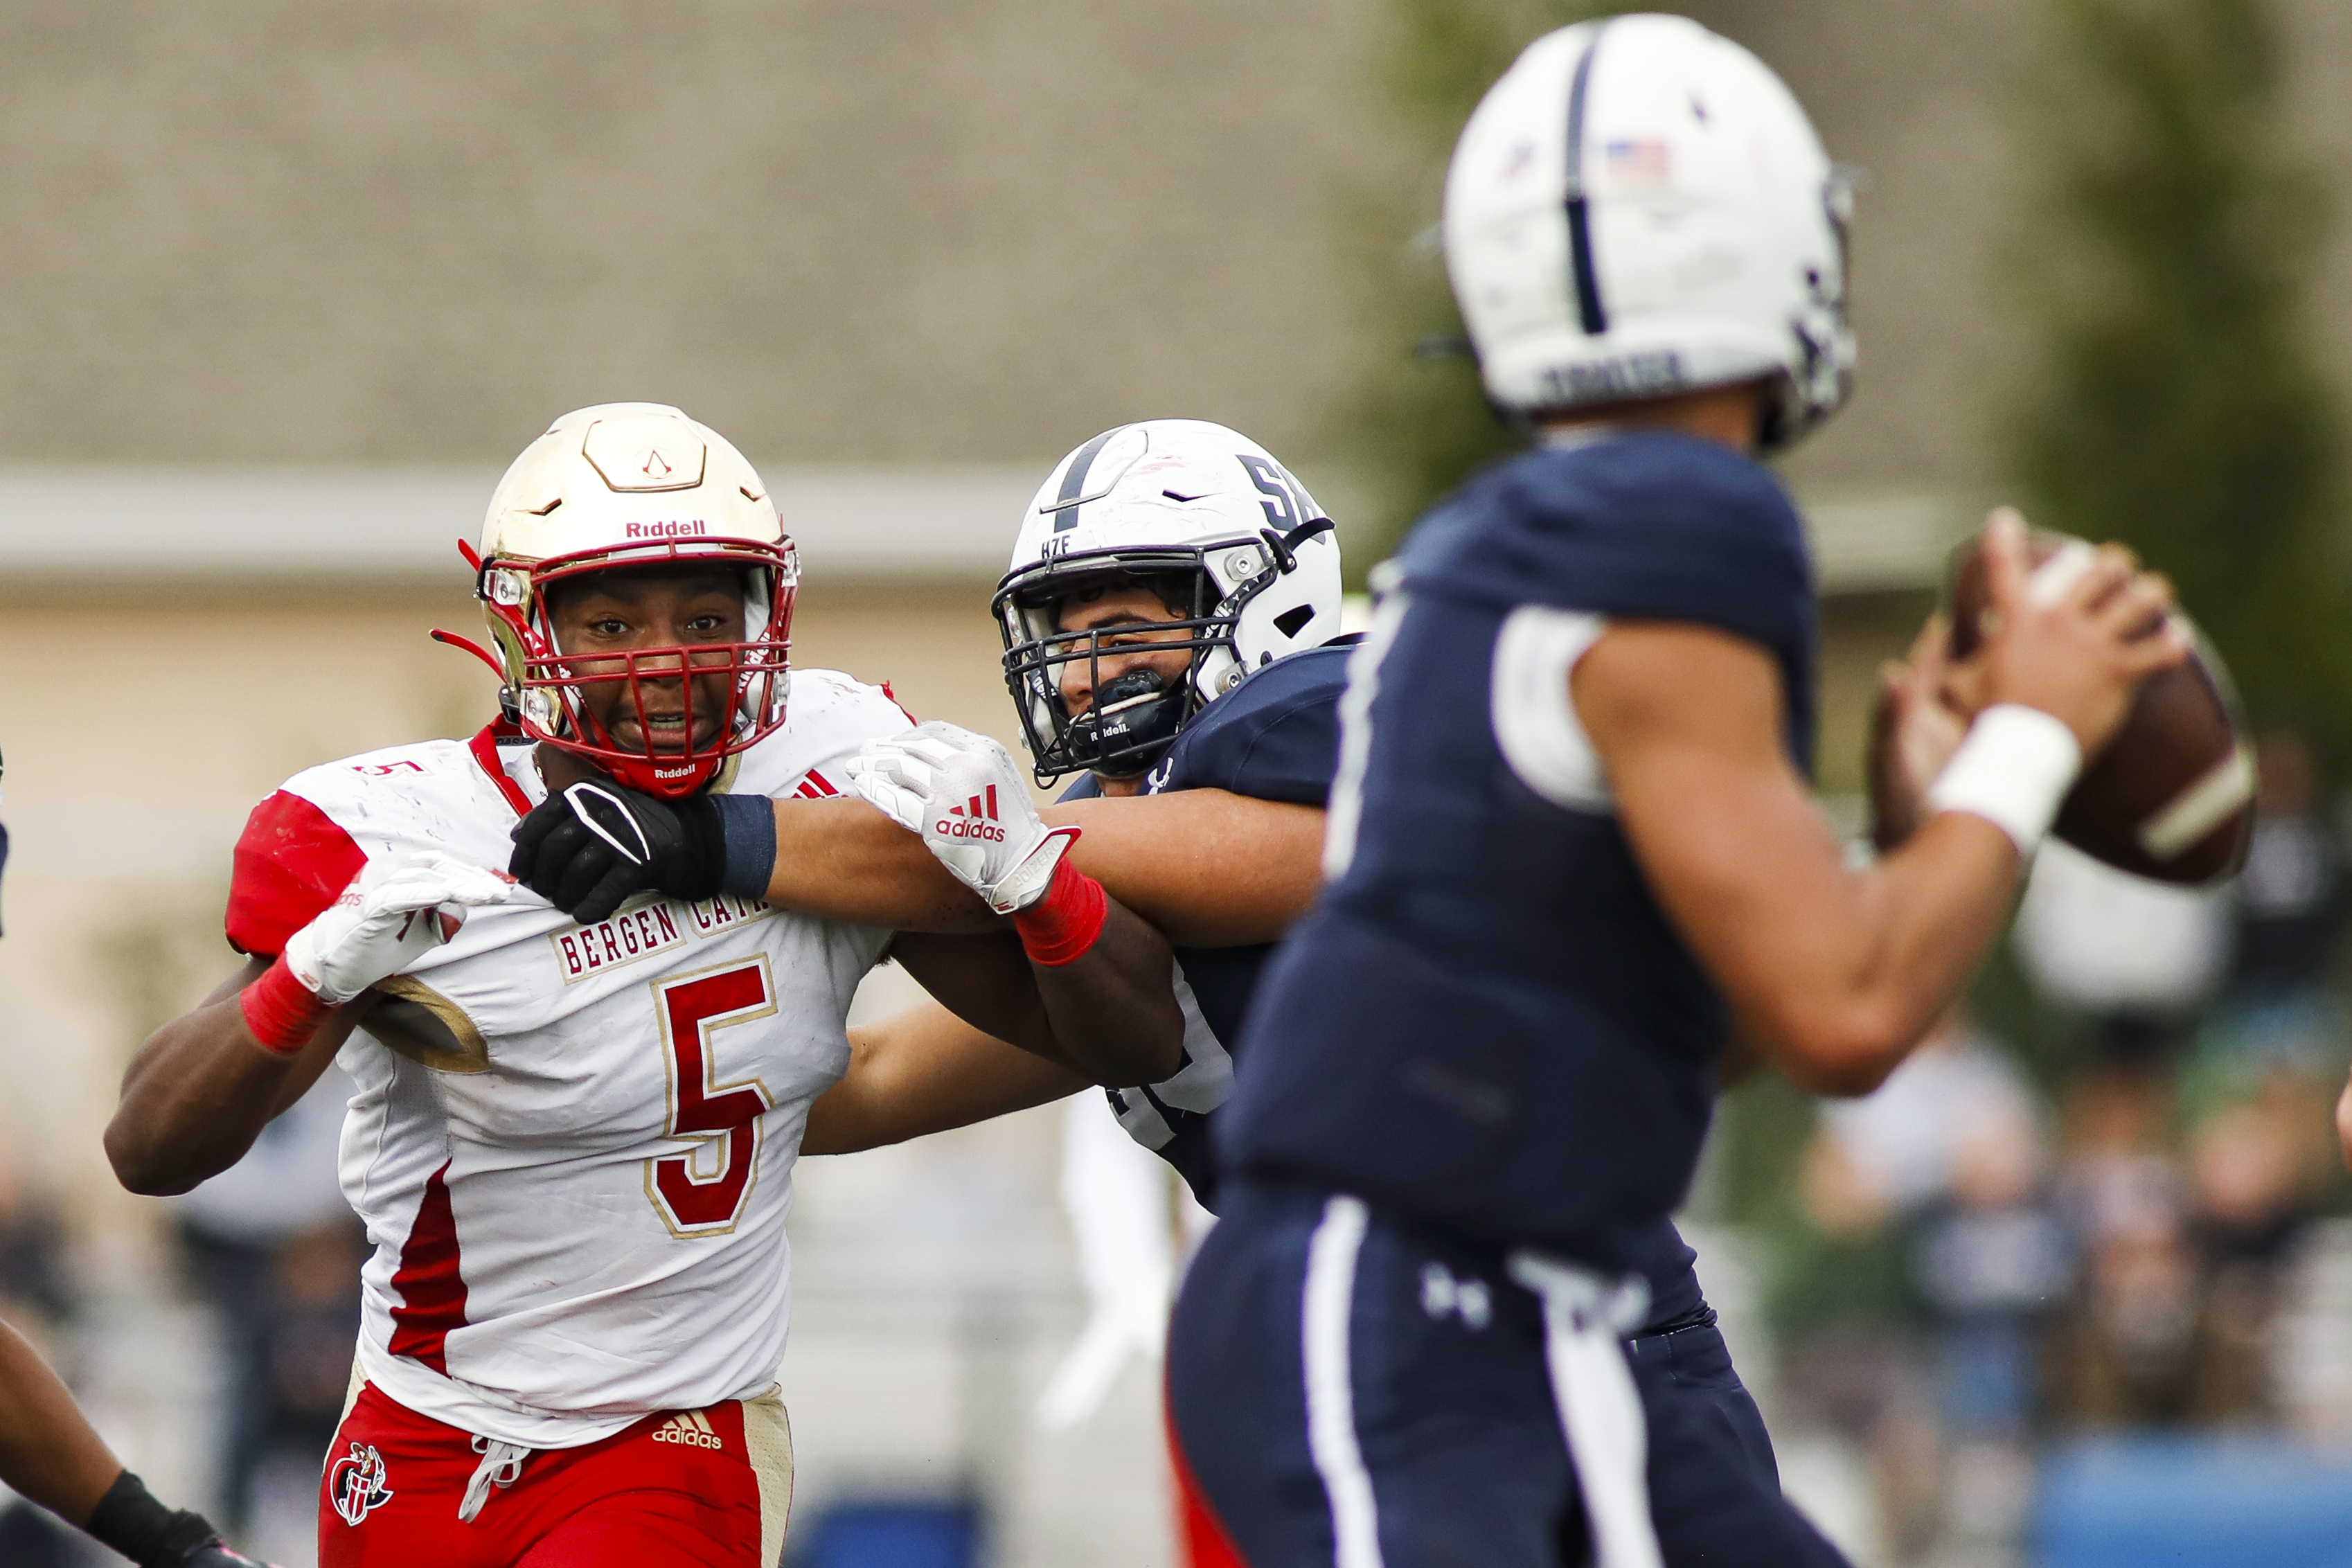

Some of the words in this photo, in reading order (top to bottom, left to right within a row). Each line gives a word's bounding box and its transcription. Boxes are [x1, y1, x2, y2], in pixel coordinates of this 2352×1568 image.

[626, 520, 706, 537] Riddell
[654, 763, 695, 778] Riddell
[936, 819, 1005, 843] adidas
[560, 902, 678, 975] BERGEN
[645, 954, 776, 1238] 5
[652, 1427, 722, 1450] adidas
